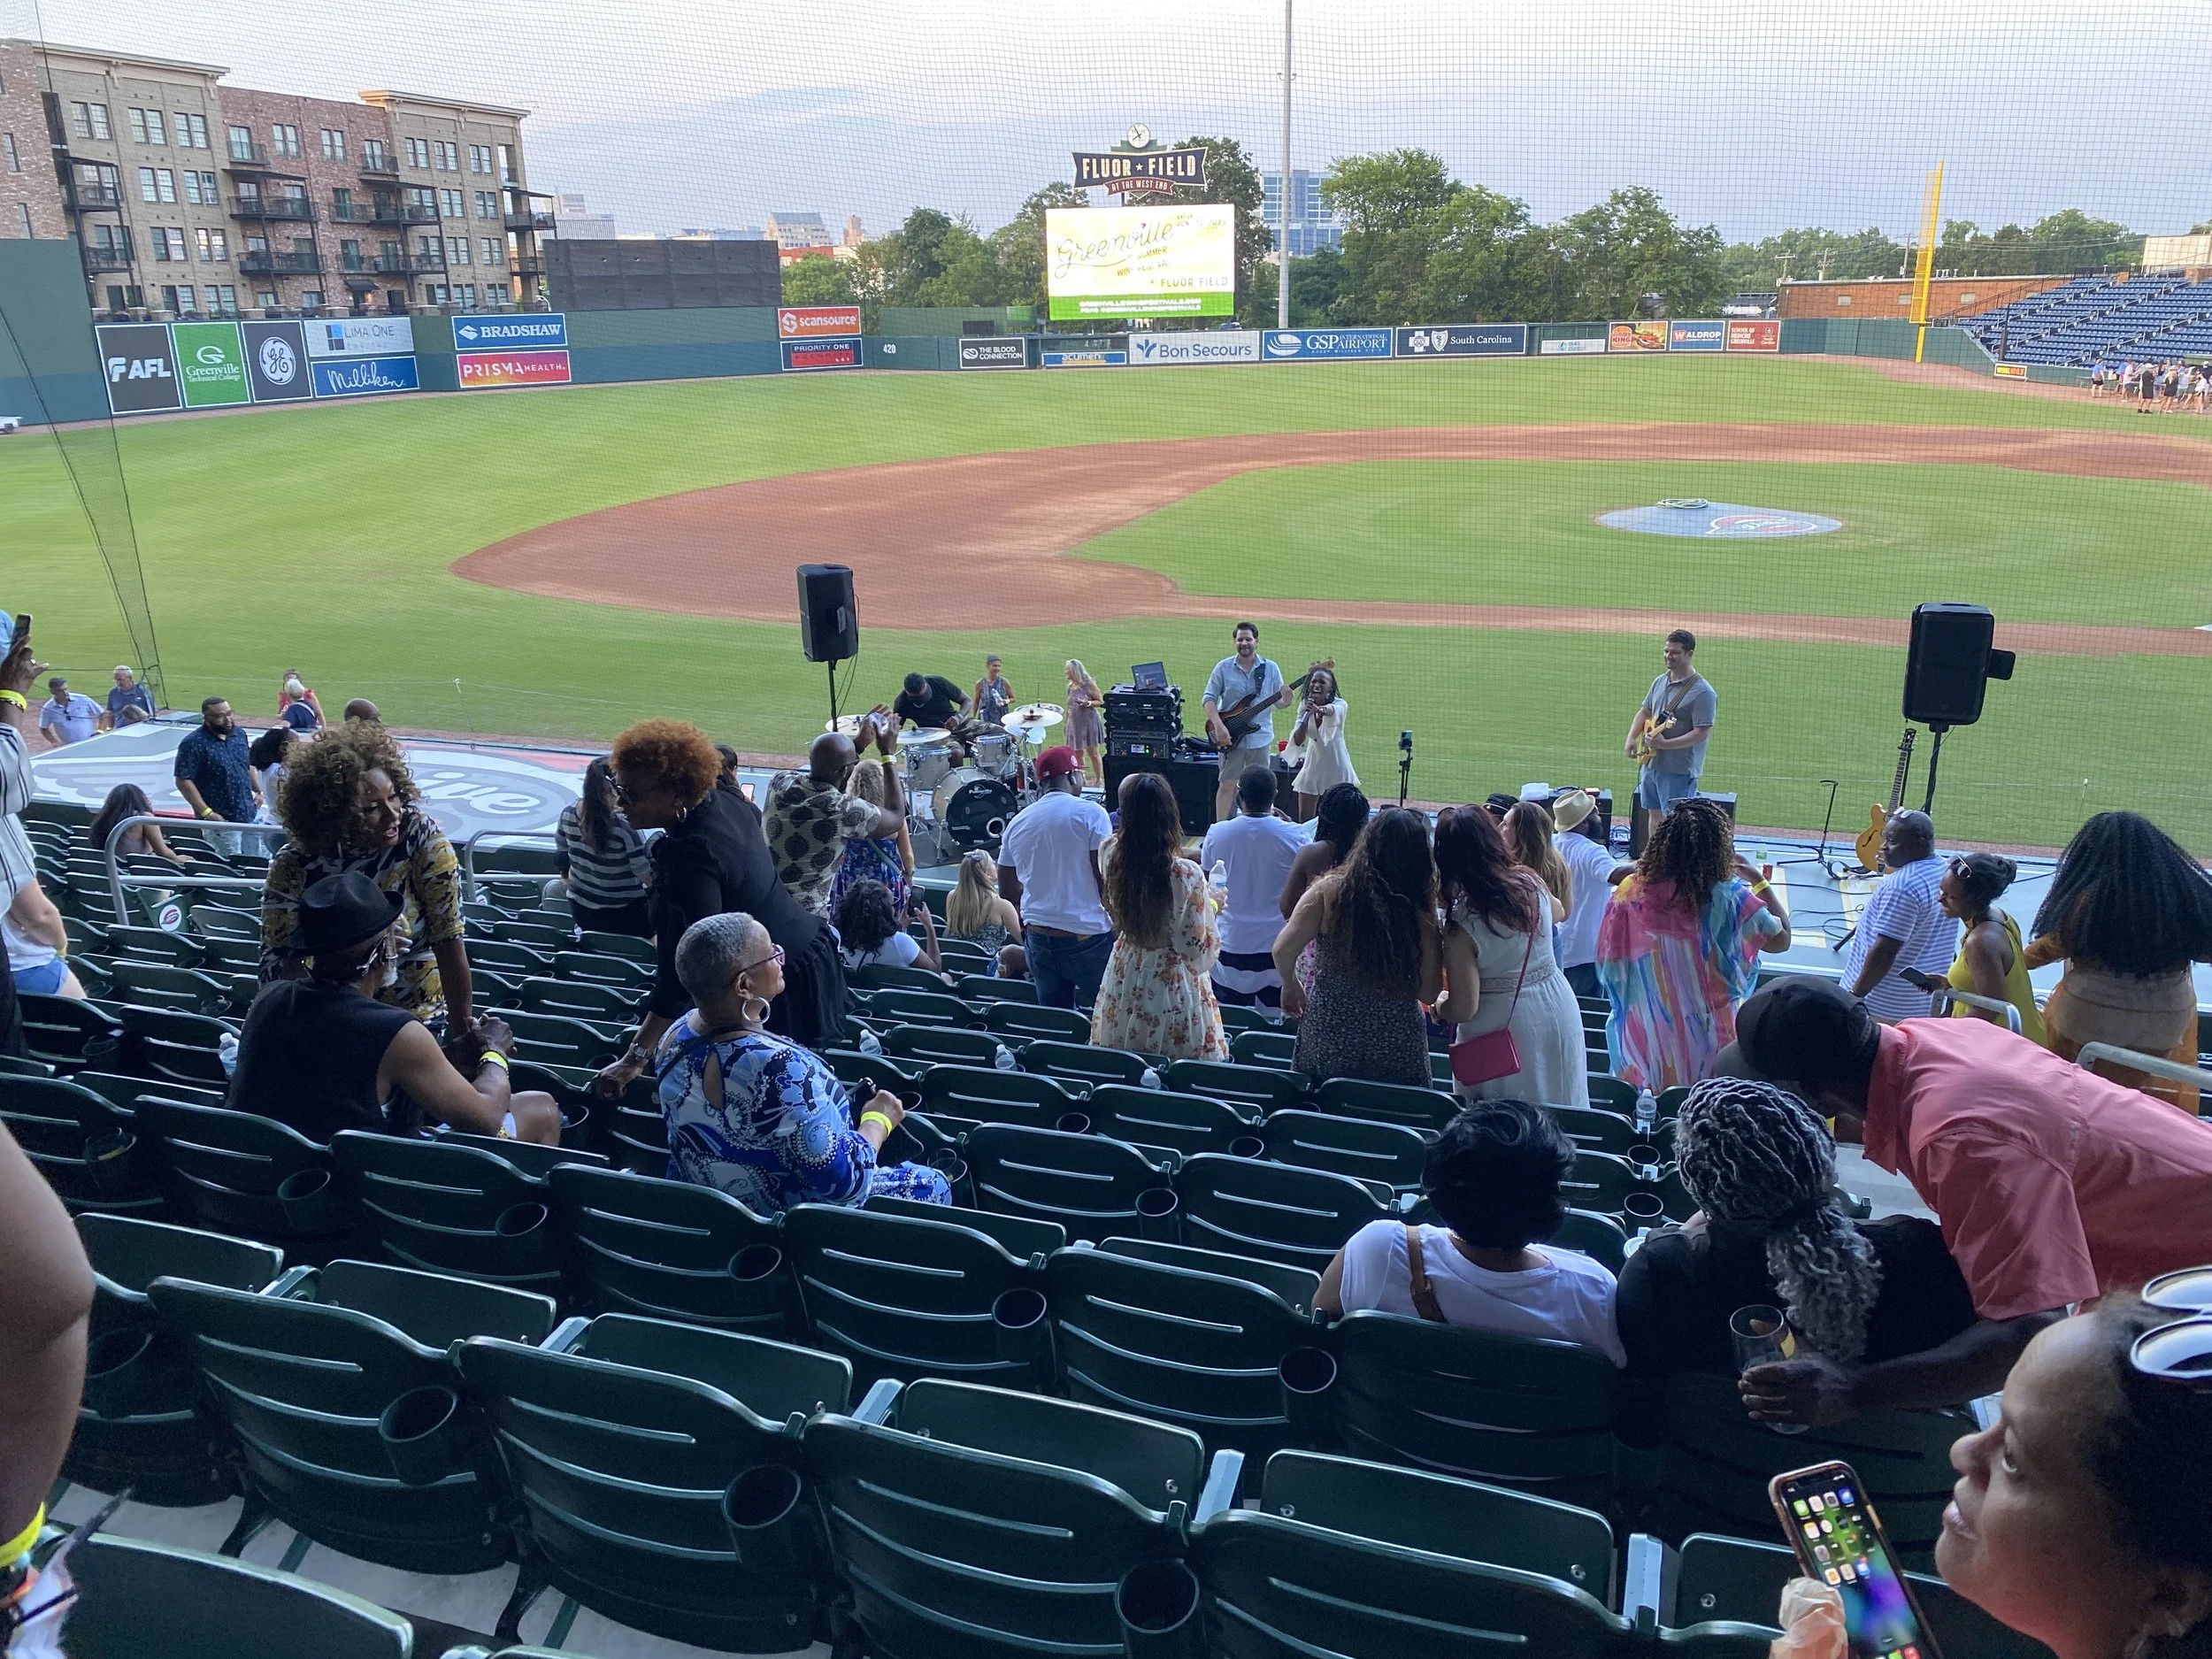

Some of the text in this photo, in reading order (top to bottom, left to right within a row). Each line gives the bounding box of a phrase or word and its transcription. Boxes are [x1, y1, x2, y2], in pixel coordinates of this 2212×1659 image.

[1082, 155, 1196, 179] FLUOR FIELD
[1121, 181, 1133, 190] THE
[1135, 180, 1153, 188] WEST
[1156, 180, 1168, 190] END
[1055, 222, 1174, 279] Greenville
[1136, 246, 1168, 259] SUMMER
[1160, 278, 1194, 288] FLUOR
[1199, 276, 1228, 287] FIELD
[799, 315, 856, 326] scansource
[343, 324, 395, 338] LIMA ONE
[480, 324, 562, 338] BRADSHAW
[1674, 330, 1722, 341] WALDROP
[1306, 334, 1340, 349] GSP
[1337, 339, 1388, 349] AIRPORT
[1450, 334, 1512, 344] South Carolina
[883, 343, 896, 354] 420
[1159, 343, 1252, 357] Bon Secours
[127, 357, 172, 380] AFL
[186, 363, 240, 376] Greenville
[463, 362, 525, 378] PRISMA
[326, 361, 404, 393] Milliken
